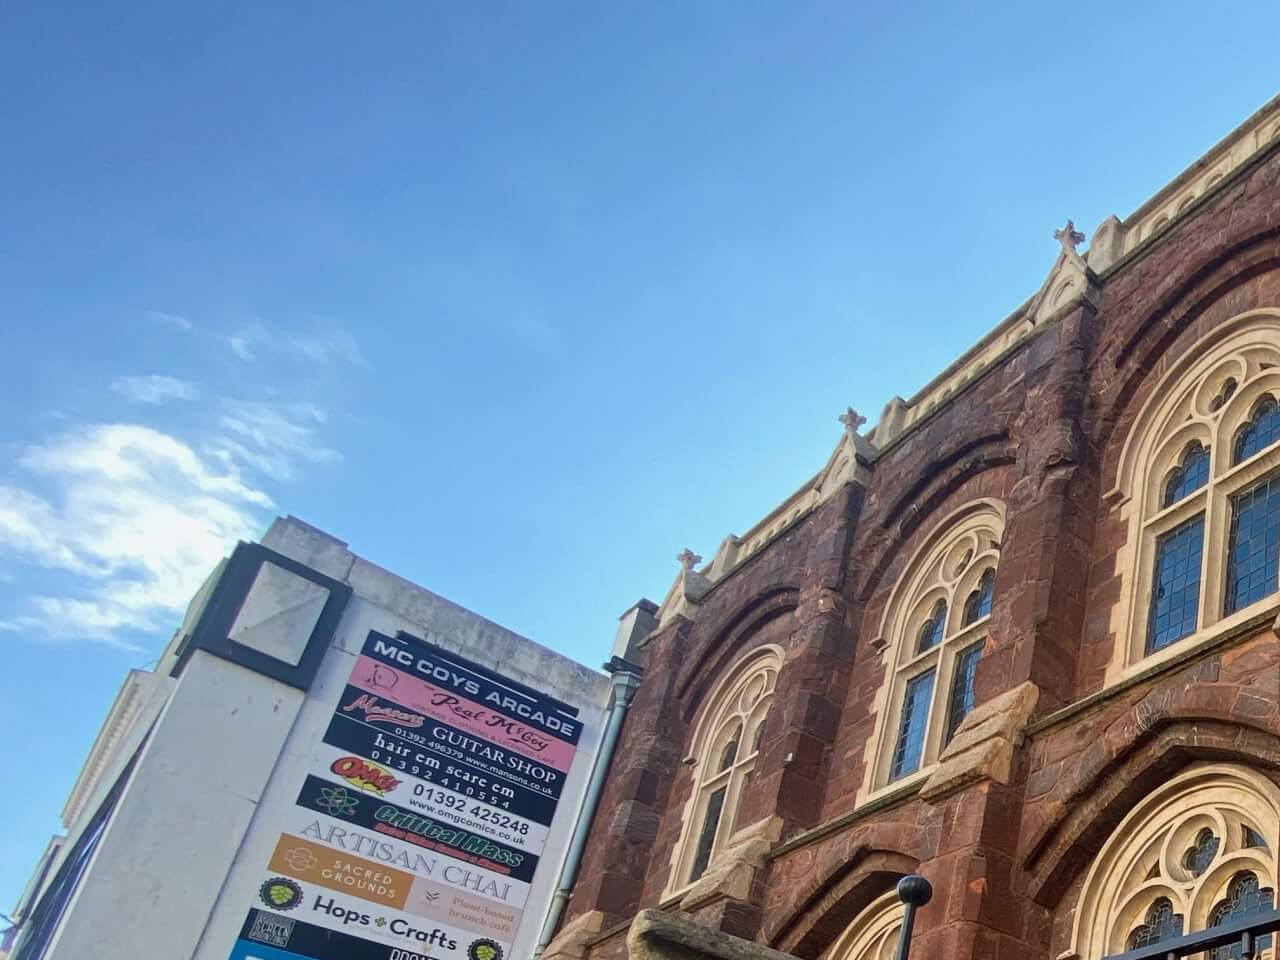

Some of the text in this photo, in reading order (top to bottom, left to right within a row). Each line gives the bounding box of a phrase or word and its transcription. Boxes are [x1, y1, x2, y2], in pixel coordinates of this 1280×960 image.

[417, 659, 480, 694] COYS
[486, 691, 575, 736] ARCADE
[431, 693, 482, 720] Real
[373, 734, 411, 758] hair
[446, 765, 487, 787] scare
[395, 727, 553, 794] 01392 496379 www.mansons.co.uk
[432, 726, 556, 783] GUITAR SHOP
[374, 805, 464, 846] Critical
[461, 834, 525, 867] Mass
[409, 798, 526, 846] www.omgcomics.co.uk
[413, 783, 529, 836] 01392 425248
[300, 820, 438, 876] ARTISAN
[442, 866, 512, 901] CHAI
[321, 869, 396, 899] GROUNDS
[333, 860, 393, 885] SACRED
[312, 896, 370, 927] Hops
[389, 919, 458, 951] Crafts
